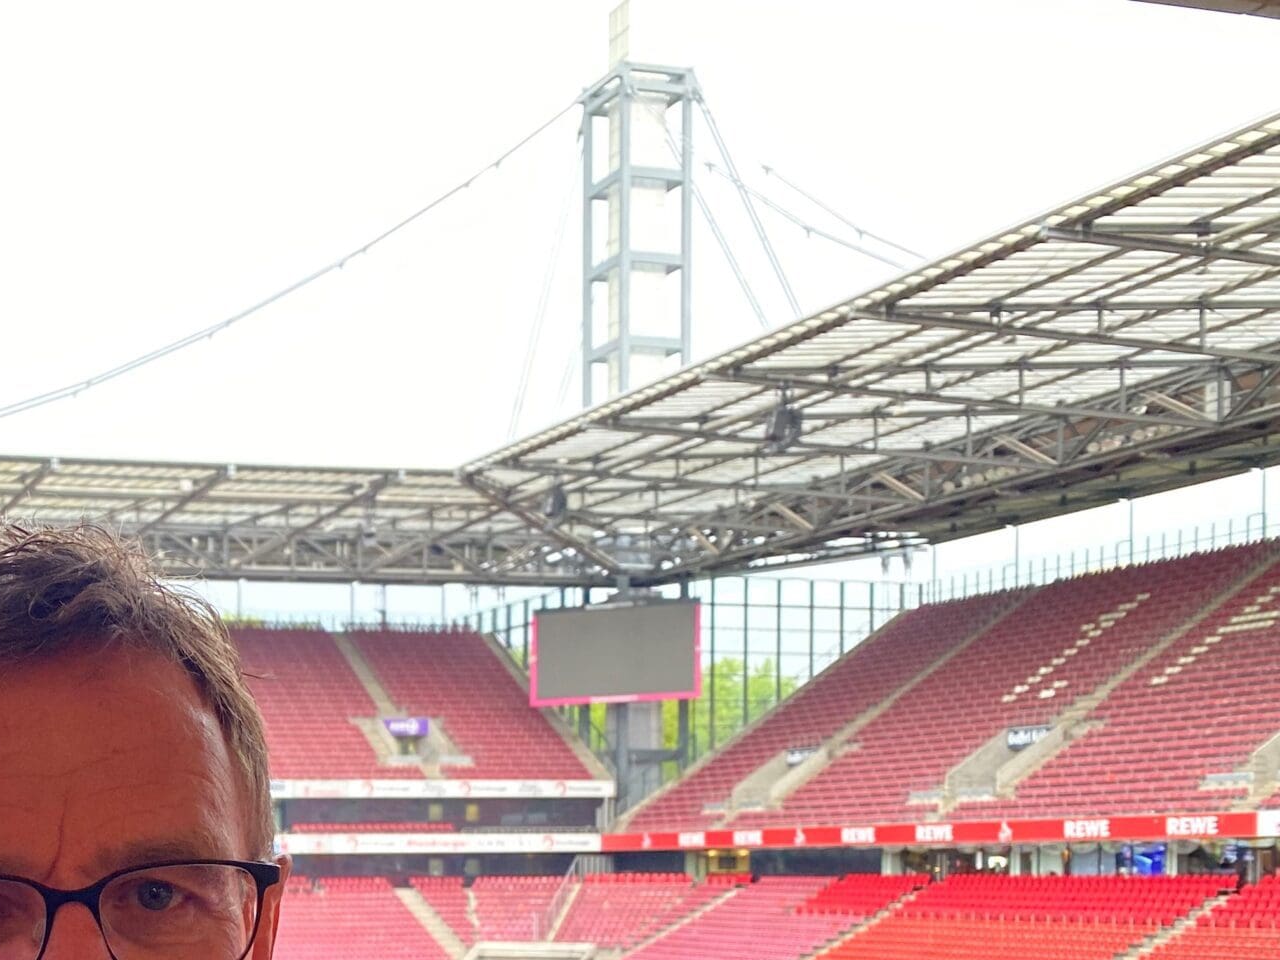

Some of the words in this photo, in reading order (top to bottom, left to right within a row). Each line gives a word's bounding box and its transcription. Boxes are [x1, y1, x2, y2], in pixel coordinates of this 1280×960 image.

[916, 825, 954, 842] REWE
[1064, 819, 1110, 838] REWE
[1167, 815, 1219, 834] REWE
